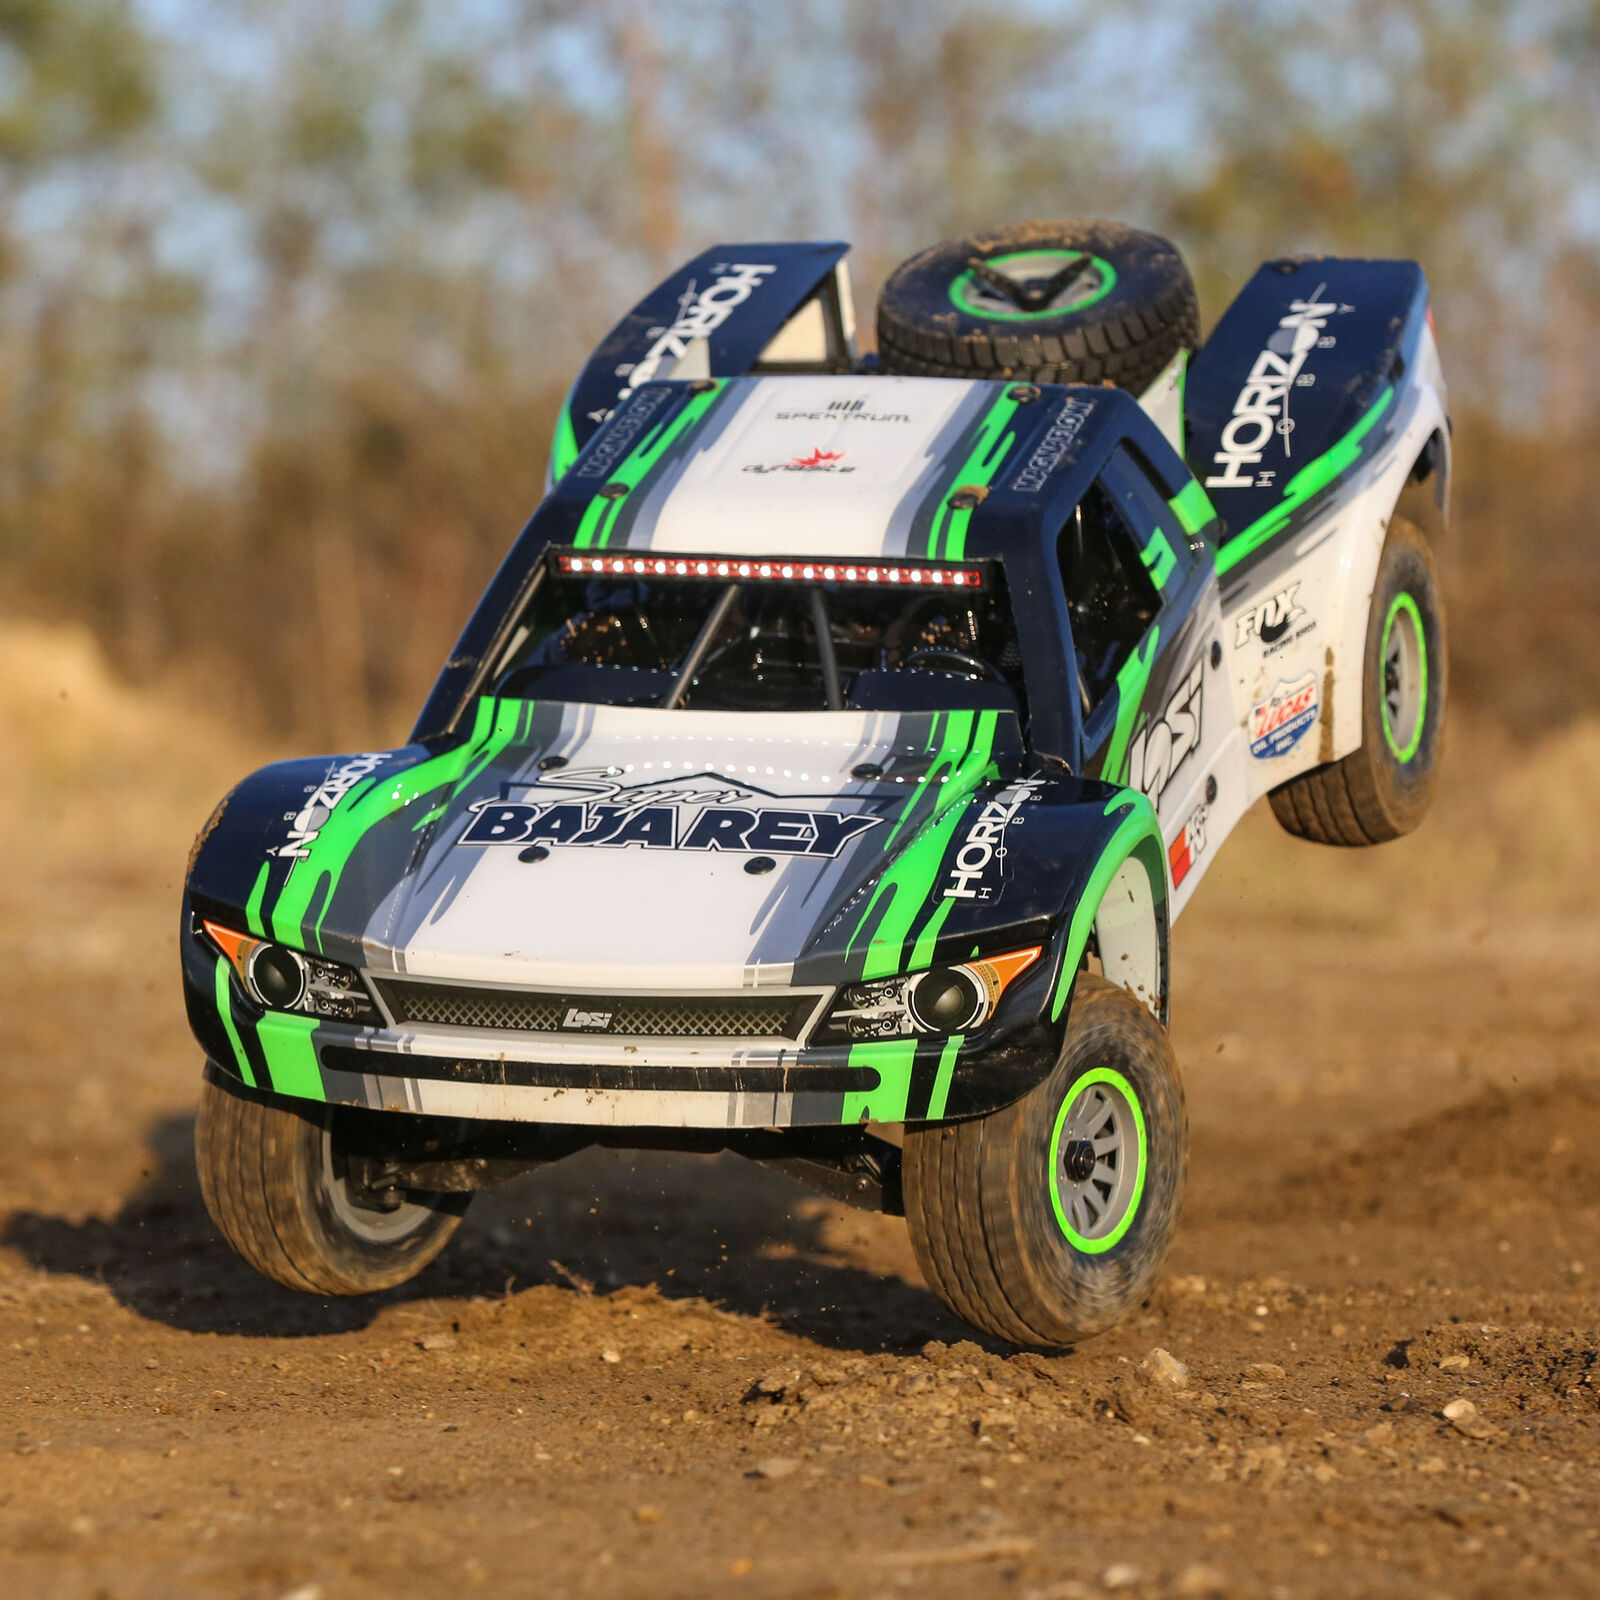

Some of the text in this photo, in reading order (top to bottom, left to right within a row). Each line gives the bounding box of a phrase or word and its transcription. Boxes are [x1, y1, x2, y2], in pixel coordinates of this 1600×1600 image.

[775, 411, 911, 423] SPEKTRUM
[1205, 302, 1337, 488] HORIZON
[1235, 581, 1307, 650] FOX
[1256, 685, 1316, 740] LUCAS
[278, 753, 393, 858] HORIZON
[468, 766, 752, 818] Super
[457, 802, 887, 859] BAJA REY
[943, 779, 1047, 899] HORIZON
